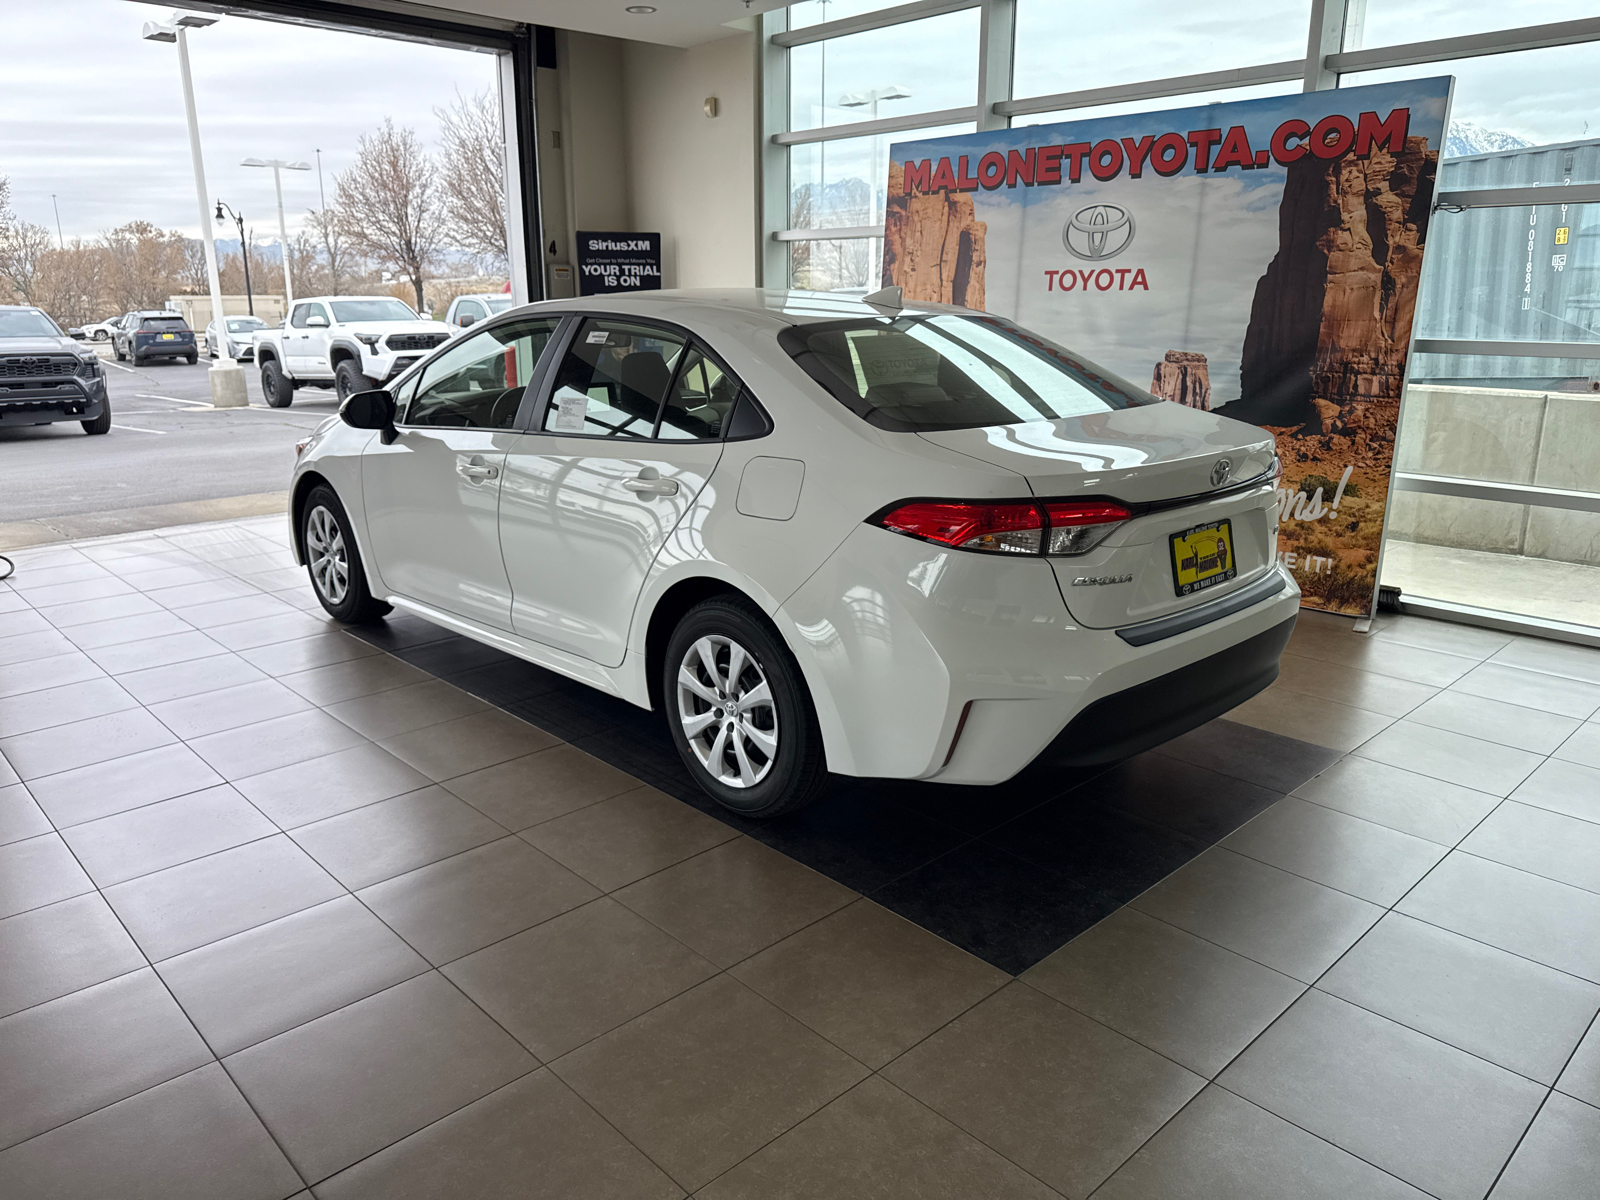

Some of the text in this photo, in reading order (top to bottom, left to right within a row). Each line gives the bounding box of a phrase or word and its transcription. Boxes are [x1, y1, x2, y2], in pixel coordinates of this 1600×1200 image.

[903, 107, 1410, 195] MALONETOYOTA.COM
[548, 239, 557, 256] 4
[588, 239, 650, 251] SiriusXM
[581, 265, 620, 276] YOUR
[621, 265, 660, 276] TRIAL
[604, 276, 641, 287] IS ON
[1044, 268, 1150, 292] TOYOTA
[1218, 542, 1225, 551] 32
[1304, 555, 1333, 575] IT!
